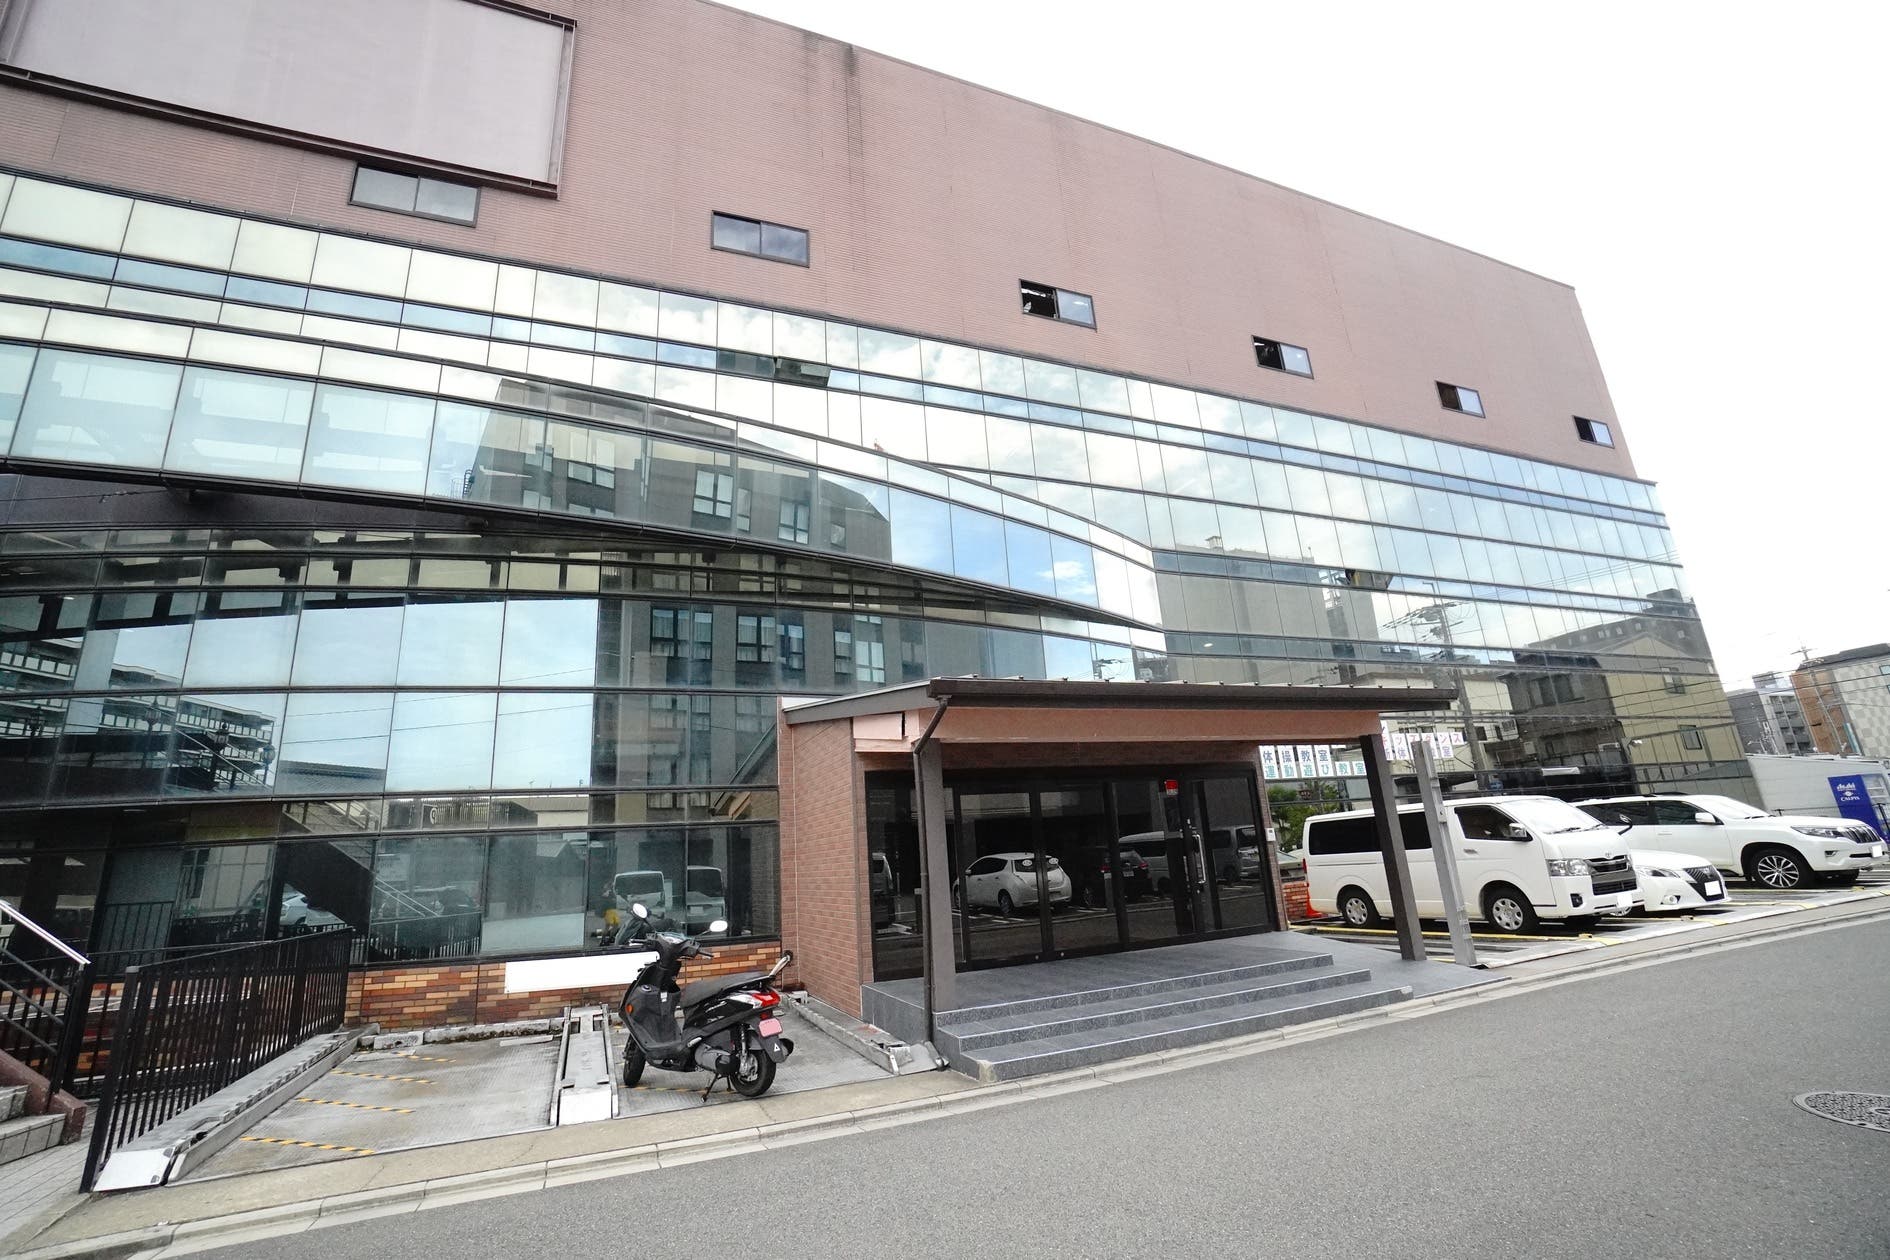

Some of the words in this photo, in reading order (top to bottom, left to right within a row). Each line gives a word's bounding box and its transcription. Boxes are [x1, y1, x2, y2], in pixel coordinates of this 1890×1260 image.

[1263, 750, 1328, 763] 体操教室
[1265, 763, 1365, 778] 運動遊び教室
